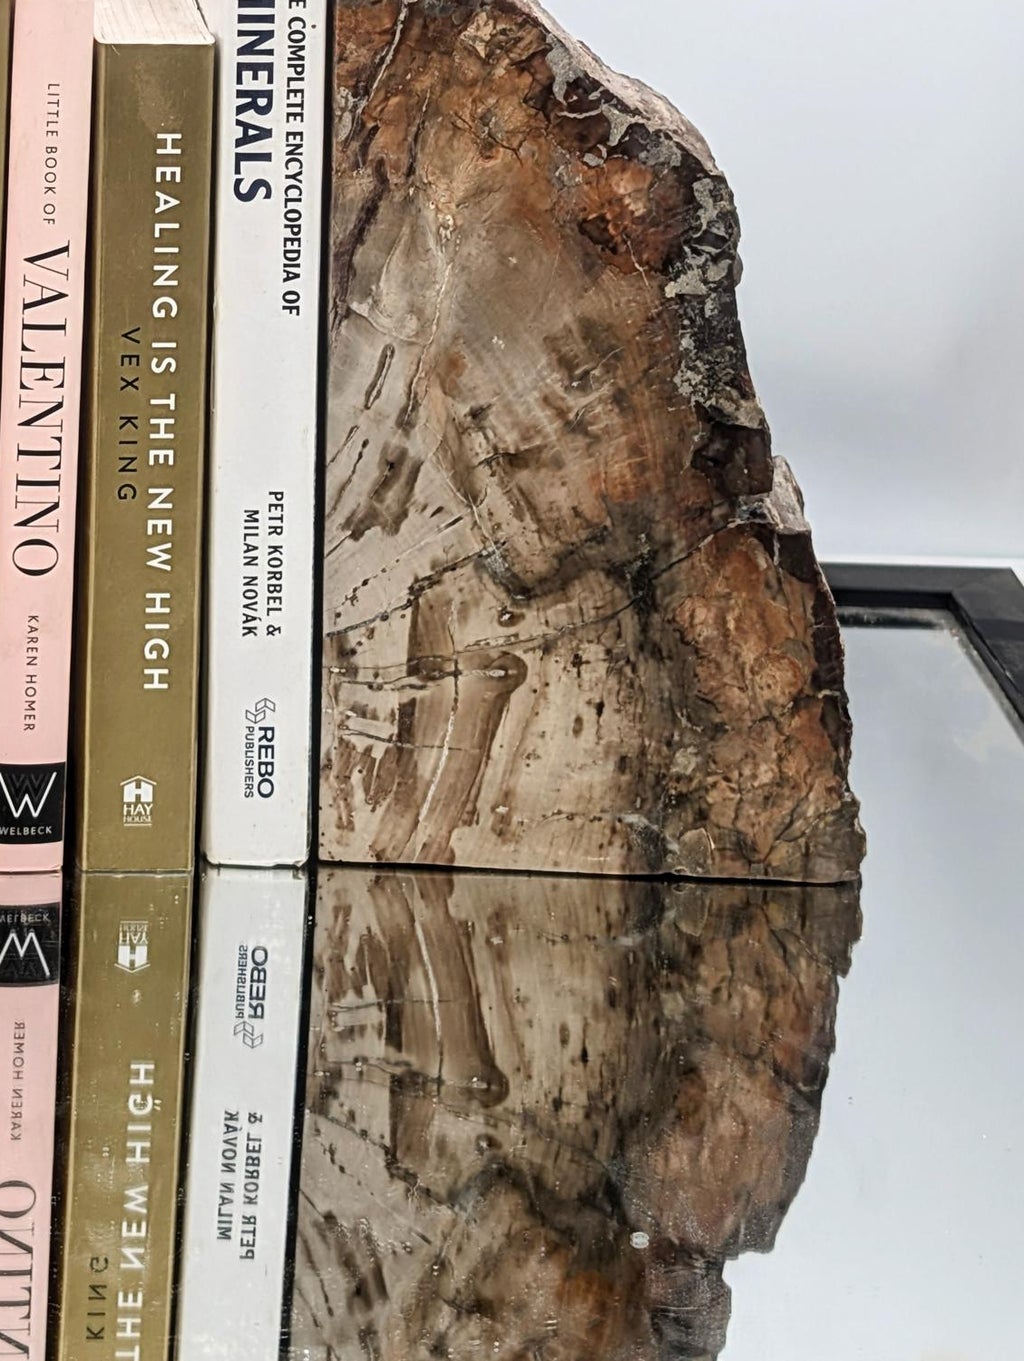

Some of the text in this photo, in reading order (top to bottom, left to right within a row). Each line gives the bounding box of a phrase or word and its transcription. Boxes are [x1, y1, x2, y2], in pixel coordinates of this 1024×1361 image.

[285, 16, 307, 125] COMPLETE
[42, 83, 61, 225] LITTLE BOOK OF
[282, 130, 304, 283] ENCYCLOPEDIA
[281, 290, 301, 317] OF
[12, 240, 70, 577] VALENTINO
[117, 326, 141, 500] VEX KING
[143, 133, 182, 689] HEALING IS THE NEW HIGH
[241, 509, 262, 637] MILAN NOVÁK
[266, 491, 284, 637] PETR KORBEL &
[23, 615, 40, 731] KAREN HOMER
[123, 803, 154, 816] HAY
[243, 725, 255, 799] PUBLISHERS
[257, 726, 275, 799] REBO
